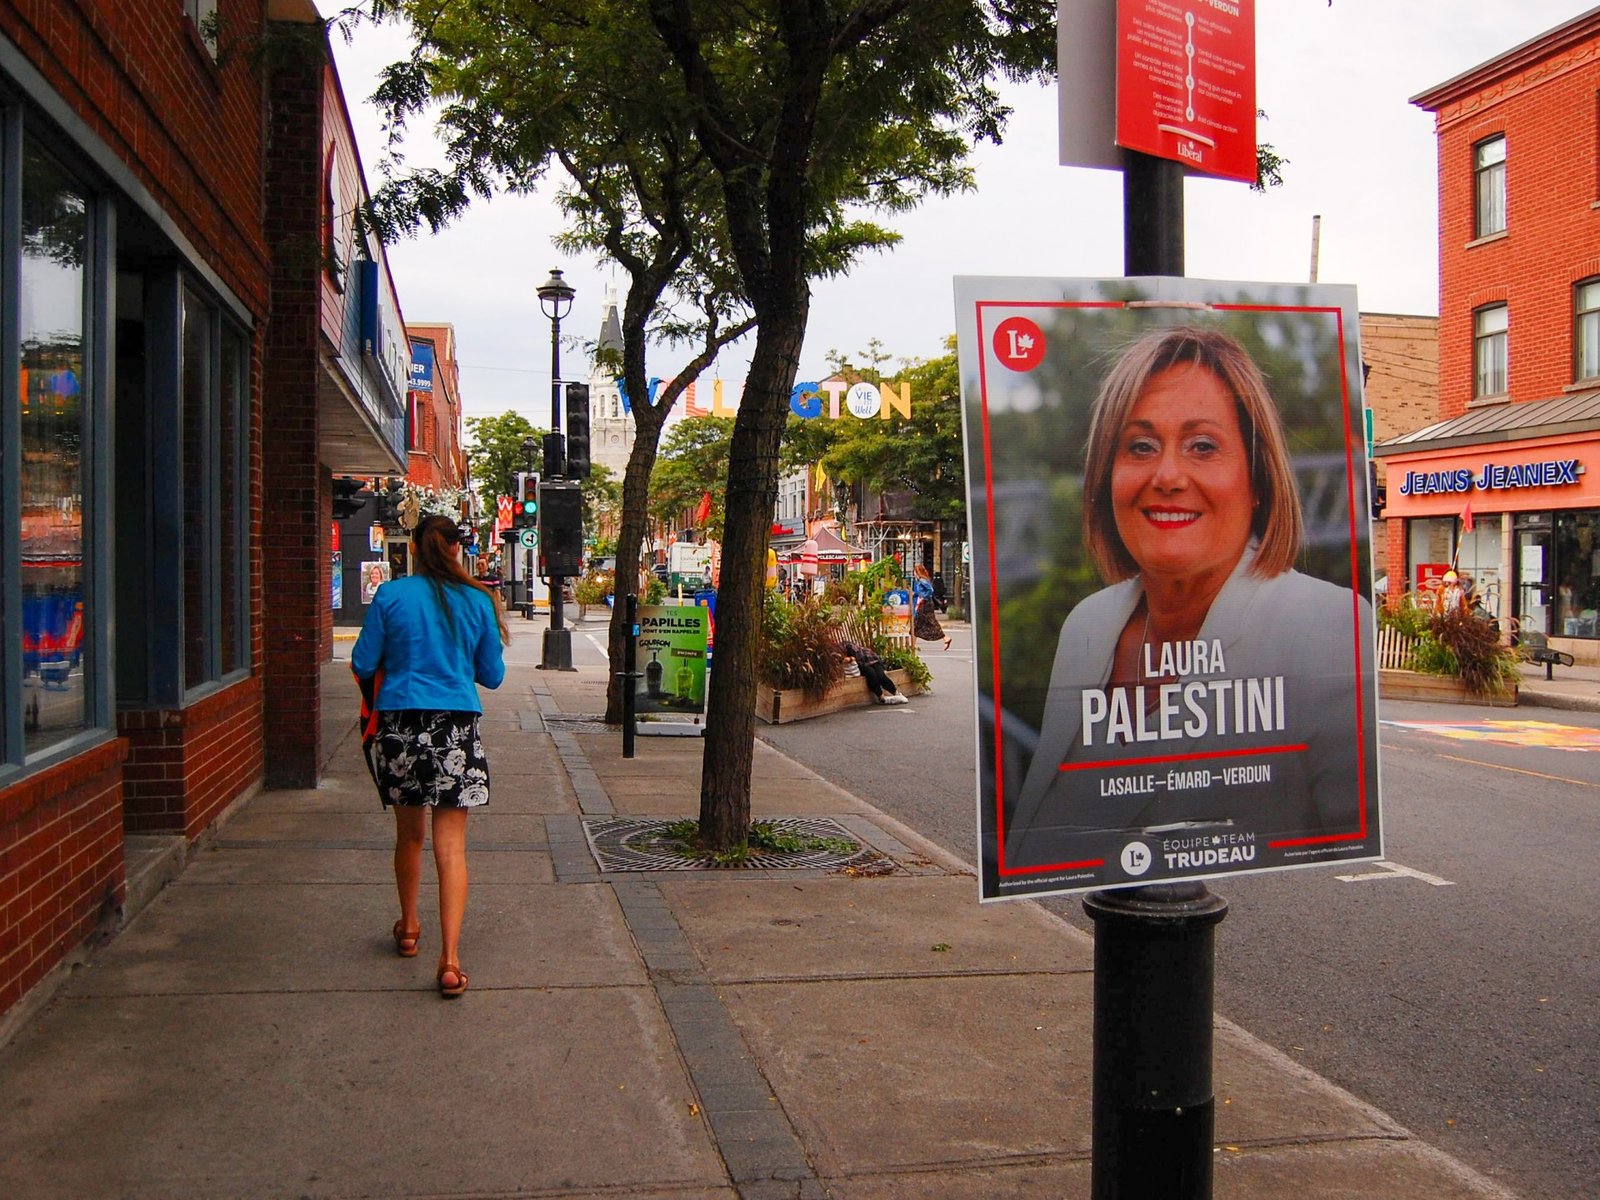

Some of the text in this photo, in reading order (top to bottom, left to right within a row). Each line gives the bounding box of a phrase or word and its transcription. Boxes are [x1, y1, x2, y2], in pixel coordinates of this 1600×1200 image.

[1208, 0, 1239, 17] VERDUN
[855, 391, 872, 401] VIE
[1400, 459, 1578, 496] JEANS JEANEX
[642, 617, 701, 628] PAPILLES
[1143, 638, 1226, 678] LAURA
[1081, 675, 1285, 746] PALESTINI
[1163, 832, 1256, 851] ÉQUIPE TEAM
[1164, 844, 1256, 869] TRUDEAU
